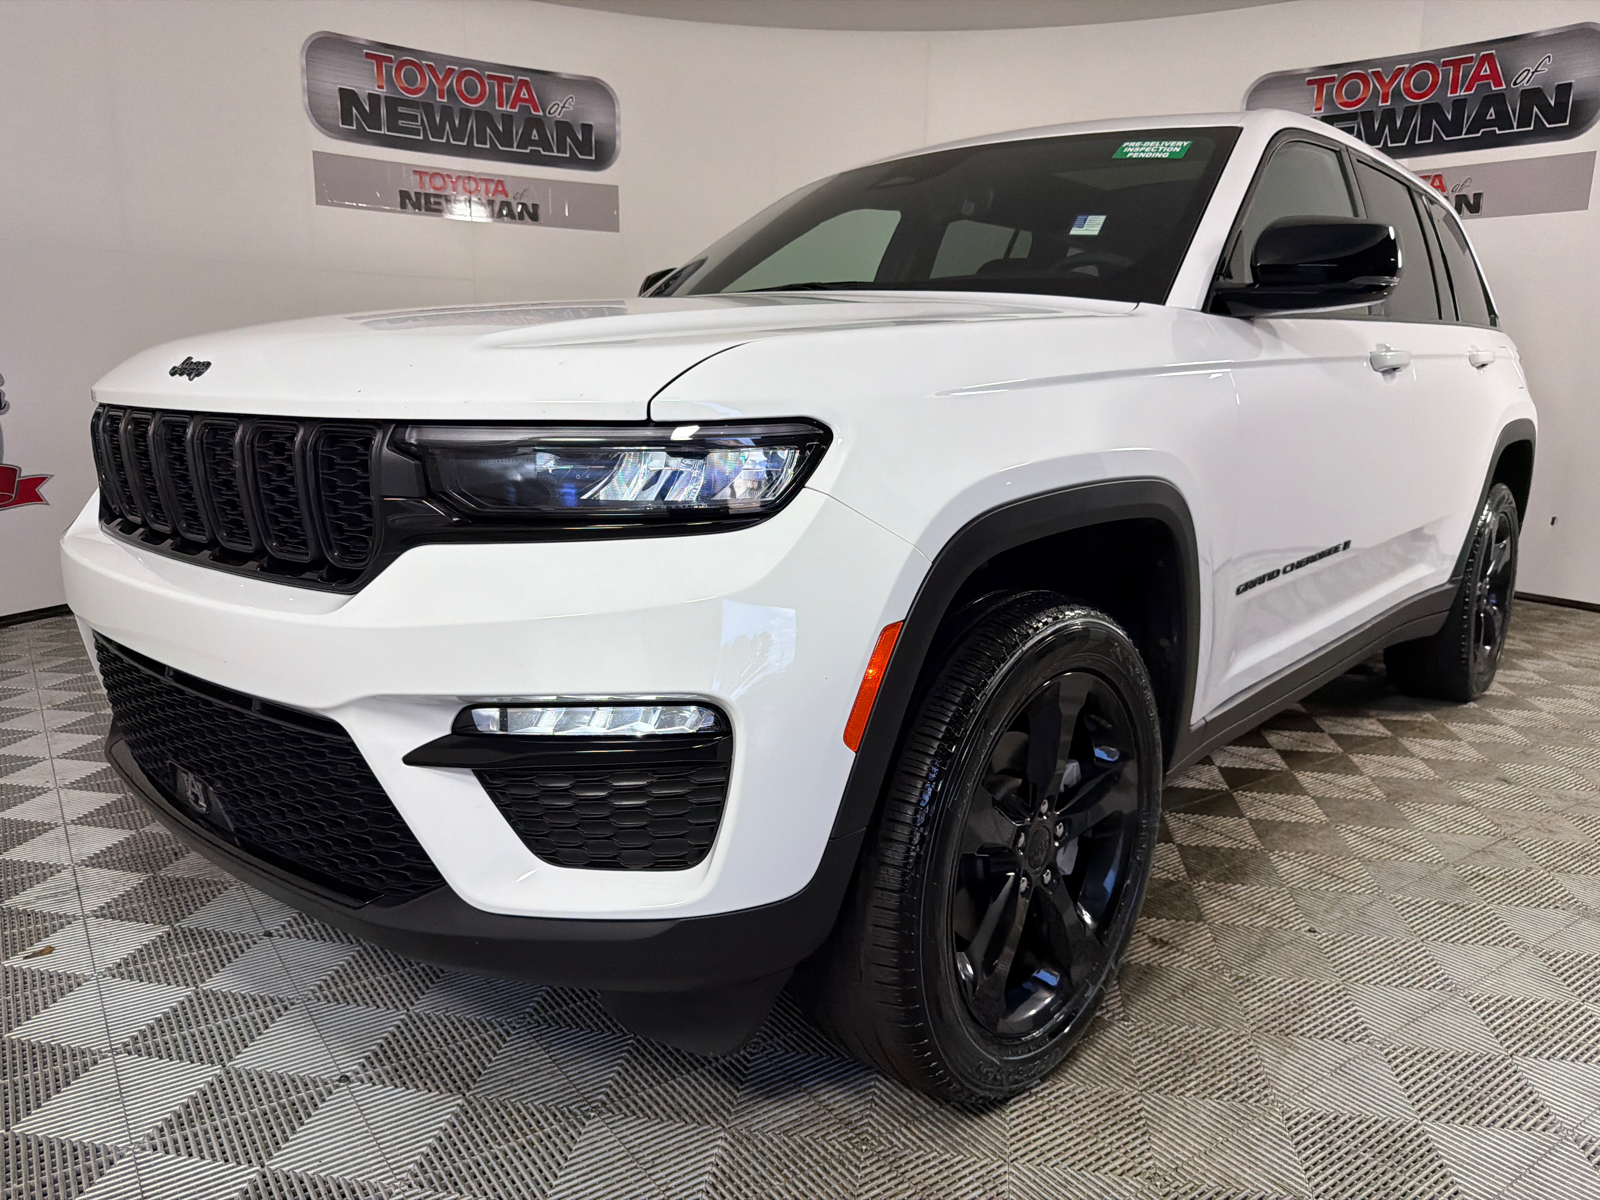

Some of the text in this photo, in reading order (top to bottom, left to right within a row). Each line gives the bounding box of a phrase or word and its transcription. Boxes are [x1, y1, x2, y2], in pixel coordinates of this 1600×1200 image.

[364, 50, 575, 118] TOYOTA of
[1306, 50, 1552, 113] TOYOTA of
[338, 87, 595, 160] NEWNAN
[1311, 80, 1574, 148] WNAN
[398, 189, 540, 222] NEAN
[413, 169, 509, 199] TOYOTA
[168, 356, 212, 381] Jeep
[1235, 543, 1342, 595] GRAND CHEROKEE
